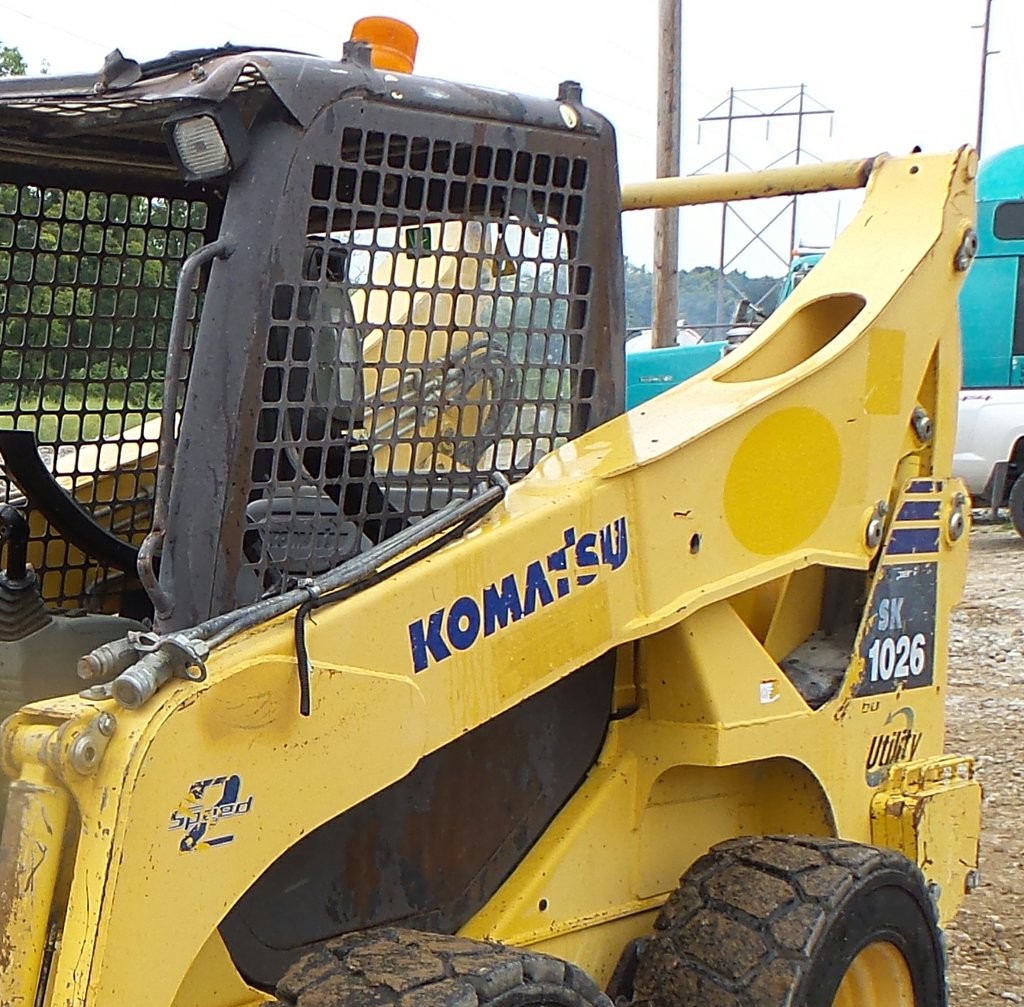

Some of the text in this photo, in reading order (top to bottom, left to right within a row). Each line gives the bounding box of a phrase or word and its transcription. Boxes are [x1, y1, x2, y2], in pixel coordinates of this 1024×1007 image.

[408, 516, 629, 674] KOMATSU
[877, 597, 905, 632] SK
[868, 632, 926, 682] 1026
[866, 728, 922, 770] Utility
